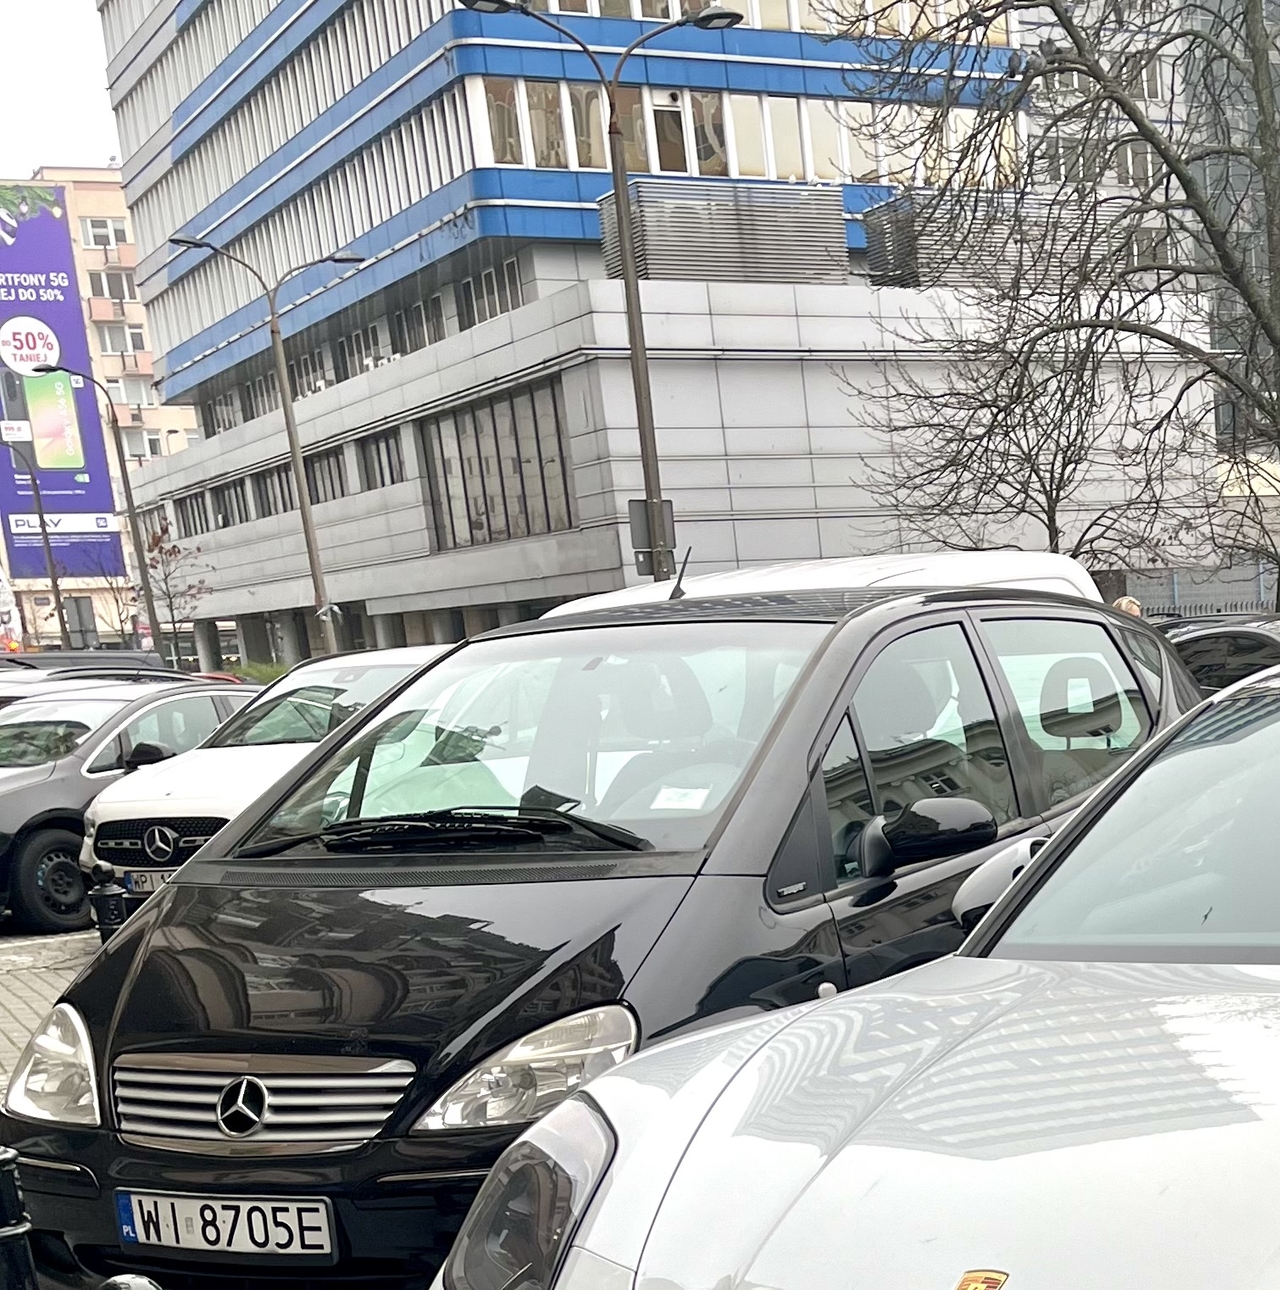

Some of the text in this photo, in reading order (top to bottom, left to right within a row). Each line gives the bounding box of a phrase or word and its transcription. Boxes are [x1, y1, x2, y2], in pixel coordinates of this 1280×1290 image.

[49, 272, 69, 286] 5G
[18, 288, 37, 301] DO
[39, 288, 65, 301] 50%
[12, 332, 54, 351] 50%
[11, 353, 48, 362] TANIEJ
[122, 1224, 136, 1238] PL
[137, 1199, 325, 1250] WI 8705E
